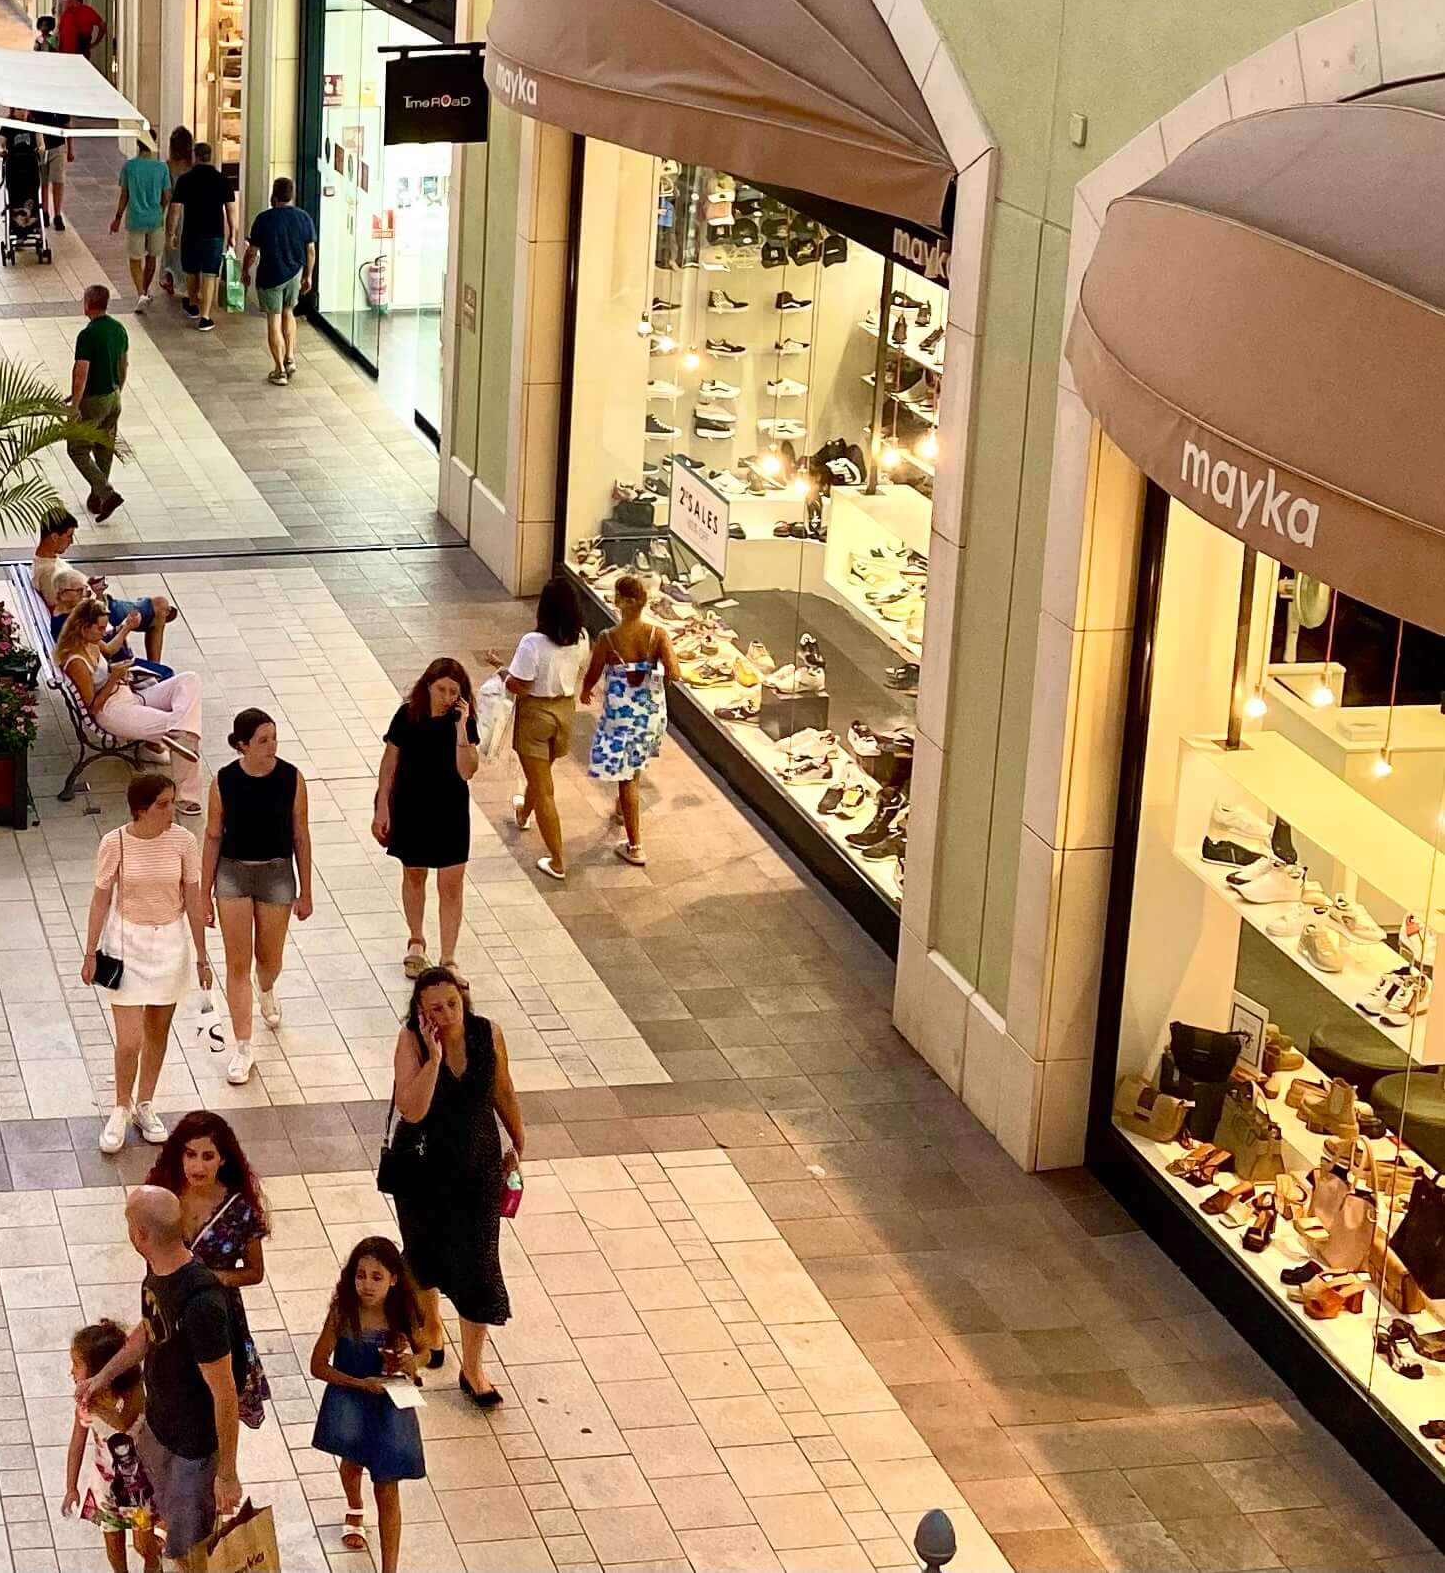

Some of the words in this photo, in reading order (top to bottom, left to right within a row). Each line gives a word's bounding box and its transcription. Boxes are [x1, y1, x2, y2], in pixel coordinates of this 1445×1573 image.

[495, 62, 538, 107] mayka
[687, 493, 719, 536] SALES
[1180, 439, 1321, 549] mayka
